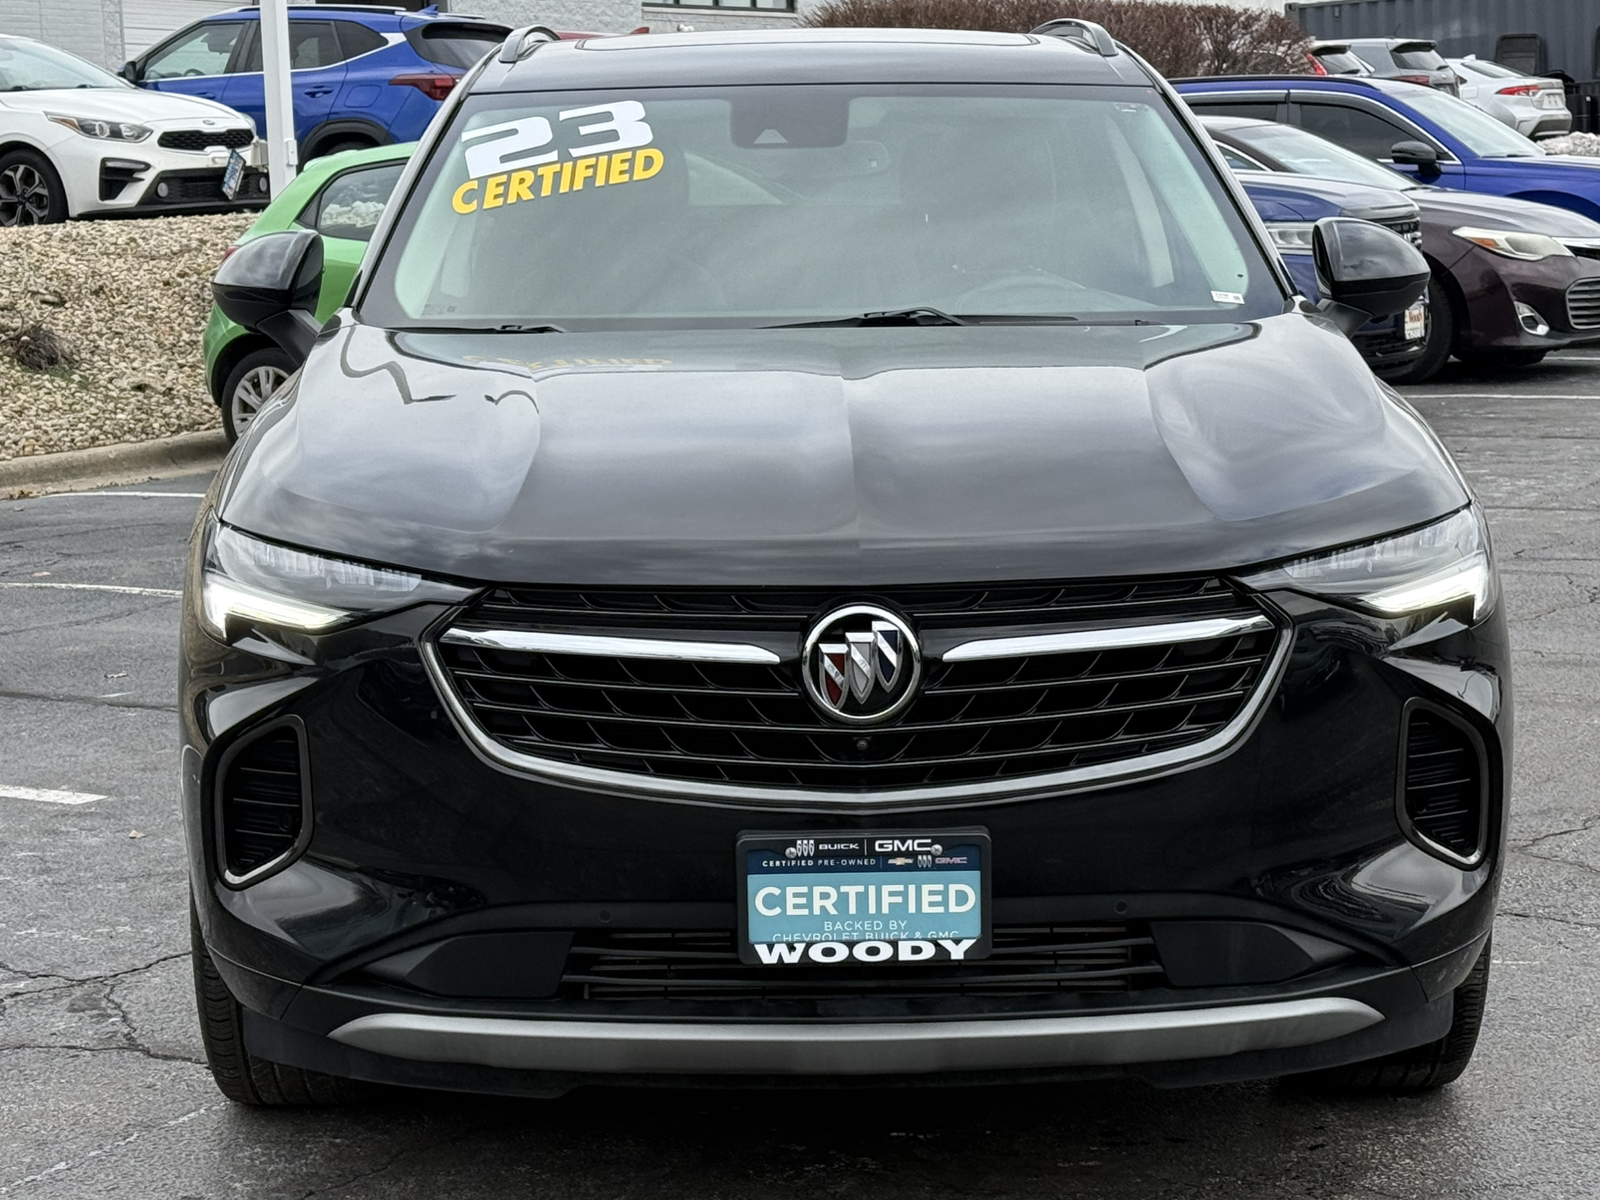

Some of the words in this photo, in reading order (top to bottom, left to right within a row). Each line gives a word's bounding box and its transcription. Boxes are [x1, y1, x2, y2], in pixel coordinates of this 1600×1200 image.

[461, 100, 654, 179] 23
[452, 148, 664, 214] CERTIFIED
[818, 842, 860, 850] BUICK
[874, 838, 932, 852] GMC
[817, 858, 876, 866] PRE-OWNED
[754, 884, 976, 916] CERTIFIED
[824, 920, 883, 931] BACKED
[889, 919, 907, 930] BY
[772, 932, 859, 942] CHEVROLET
[865, 931, 909, 940] BUICK
[754, 940, 977, 964] WOODY
